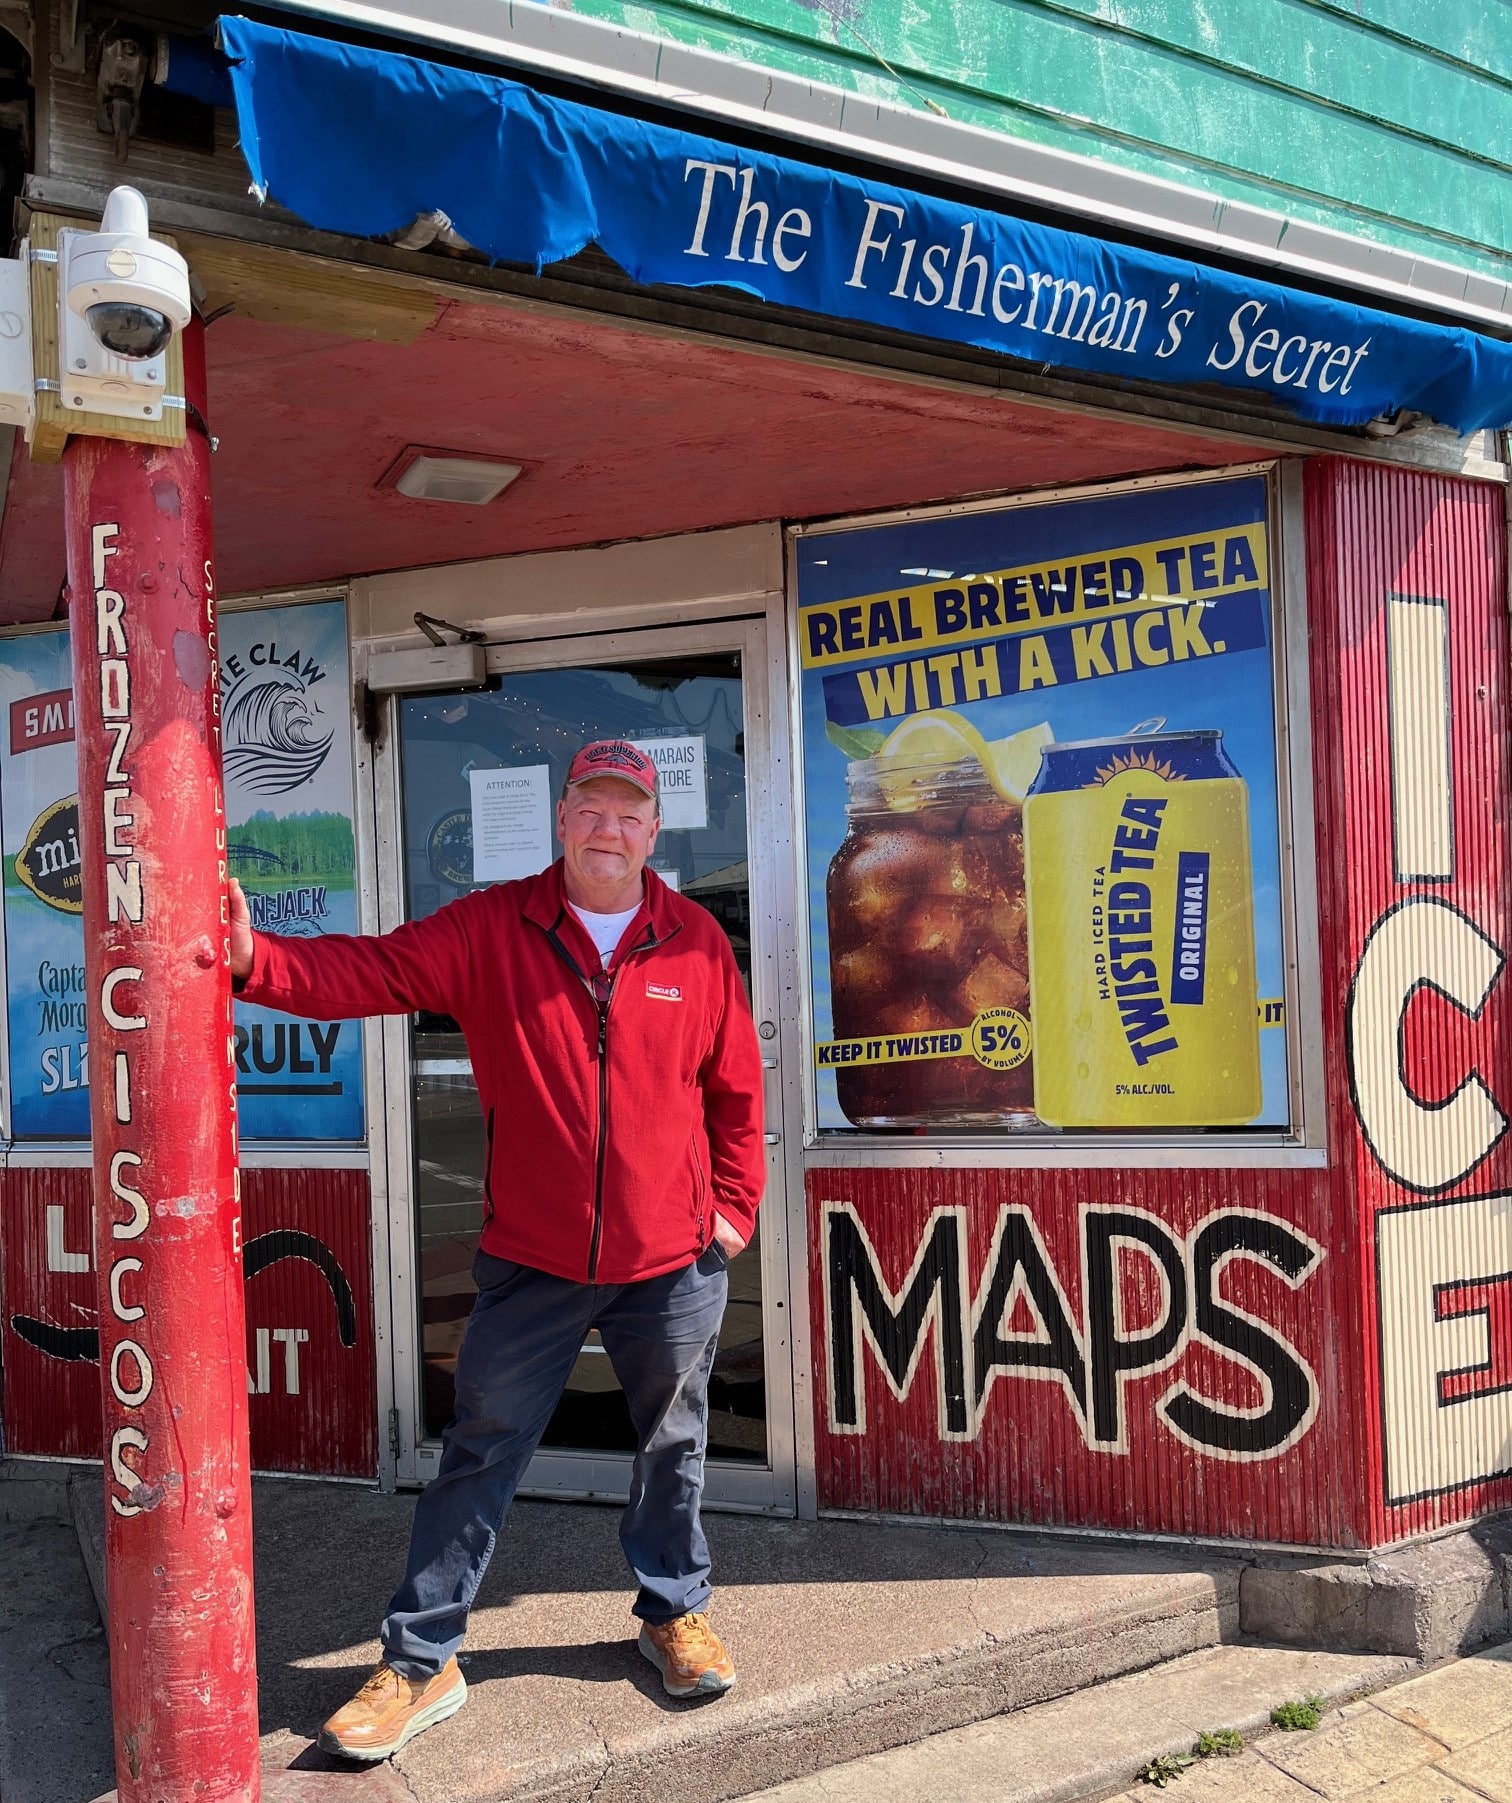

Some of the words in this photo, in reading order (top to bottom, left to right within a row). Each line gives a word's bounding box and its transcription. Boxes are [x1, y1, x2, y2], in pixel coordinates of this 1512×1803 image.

[683, 158, 812, 272] The
[844, 199, 1195, 359] Fisherman's
[1206, 300, 1373, 395] Secret
[806, 597, 923, 658] REAL
[934, 557, 1145, 636] BREWED
[1155, 536, 1260, 596] TEA
[249, 643, 326, 686] CLAW
[857, 645, 1002, 720] WITH
[1018, 637, 1058, 691] A
[1071, 603, 1226, 680] KICK.
[92, 522, 143, 925] FROZEN
[648, 746, 695, 766] MARAIS
[1110, 798, 1169, 873] TEA
[1093, 866, 1106, 897] TEA
[204, 559, 221, 749] SECRET
[213, 785, 232, 966] LURES
[226, 995, 241, 1255] INSIDE
[1093, 904, 1103, 945] ICED
[1179, 873, 1204, 981] ORIGINAL
[38, 961, 86, 999] Capta
[1094, 953, 1111, 1000] HARD
[1108, 881, 1179, 1066] TWISTED
[981, 1009, 1016, 1021] ALCOHOL
[1265, 1002, 1284, 1023] IT
[818, 1043, 863, 1064] KEEP
[867, 1041, 882, 1060] IT
[886, 1033, 962, 1057] TWISTED
[981, 1024, 1021, 1052] 5%
[981, 1055, 992, 1065] BY
[994, 1052, 1025, 1068] VOLUME
[1348, 593, 1512, 1507] ICE
[1116, 1085, 1130, 1095] 5%
[1132, 1084, 1175, 1095] ALC./VOL.
[101, 966, 154, 1516] CISCOS
[821, 1200, 1328, 1463] MAPS
